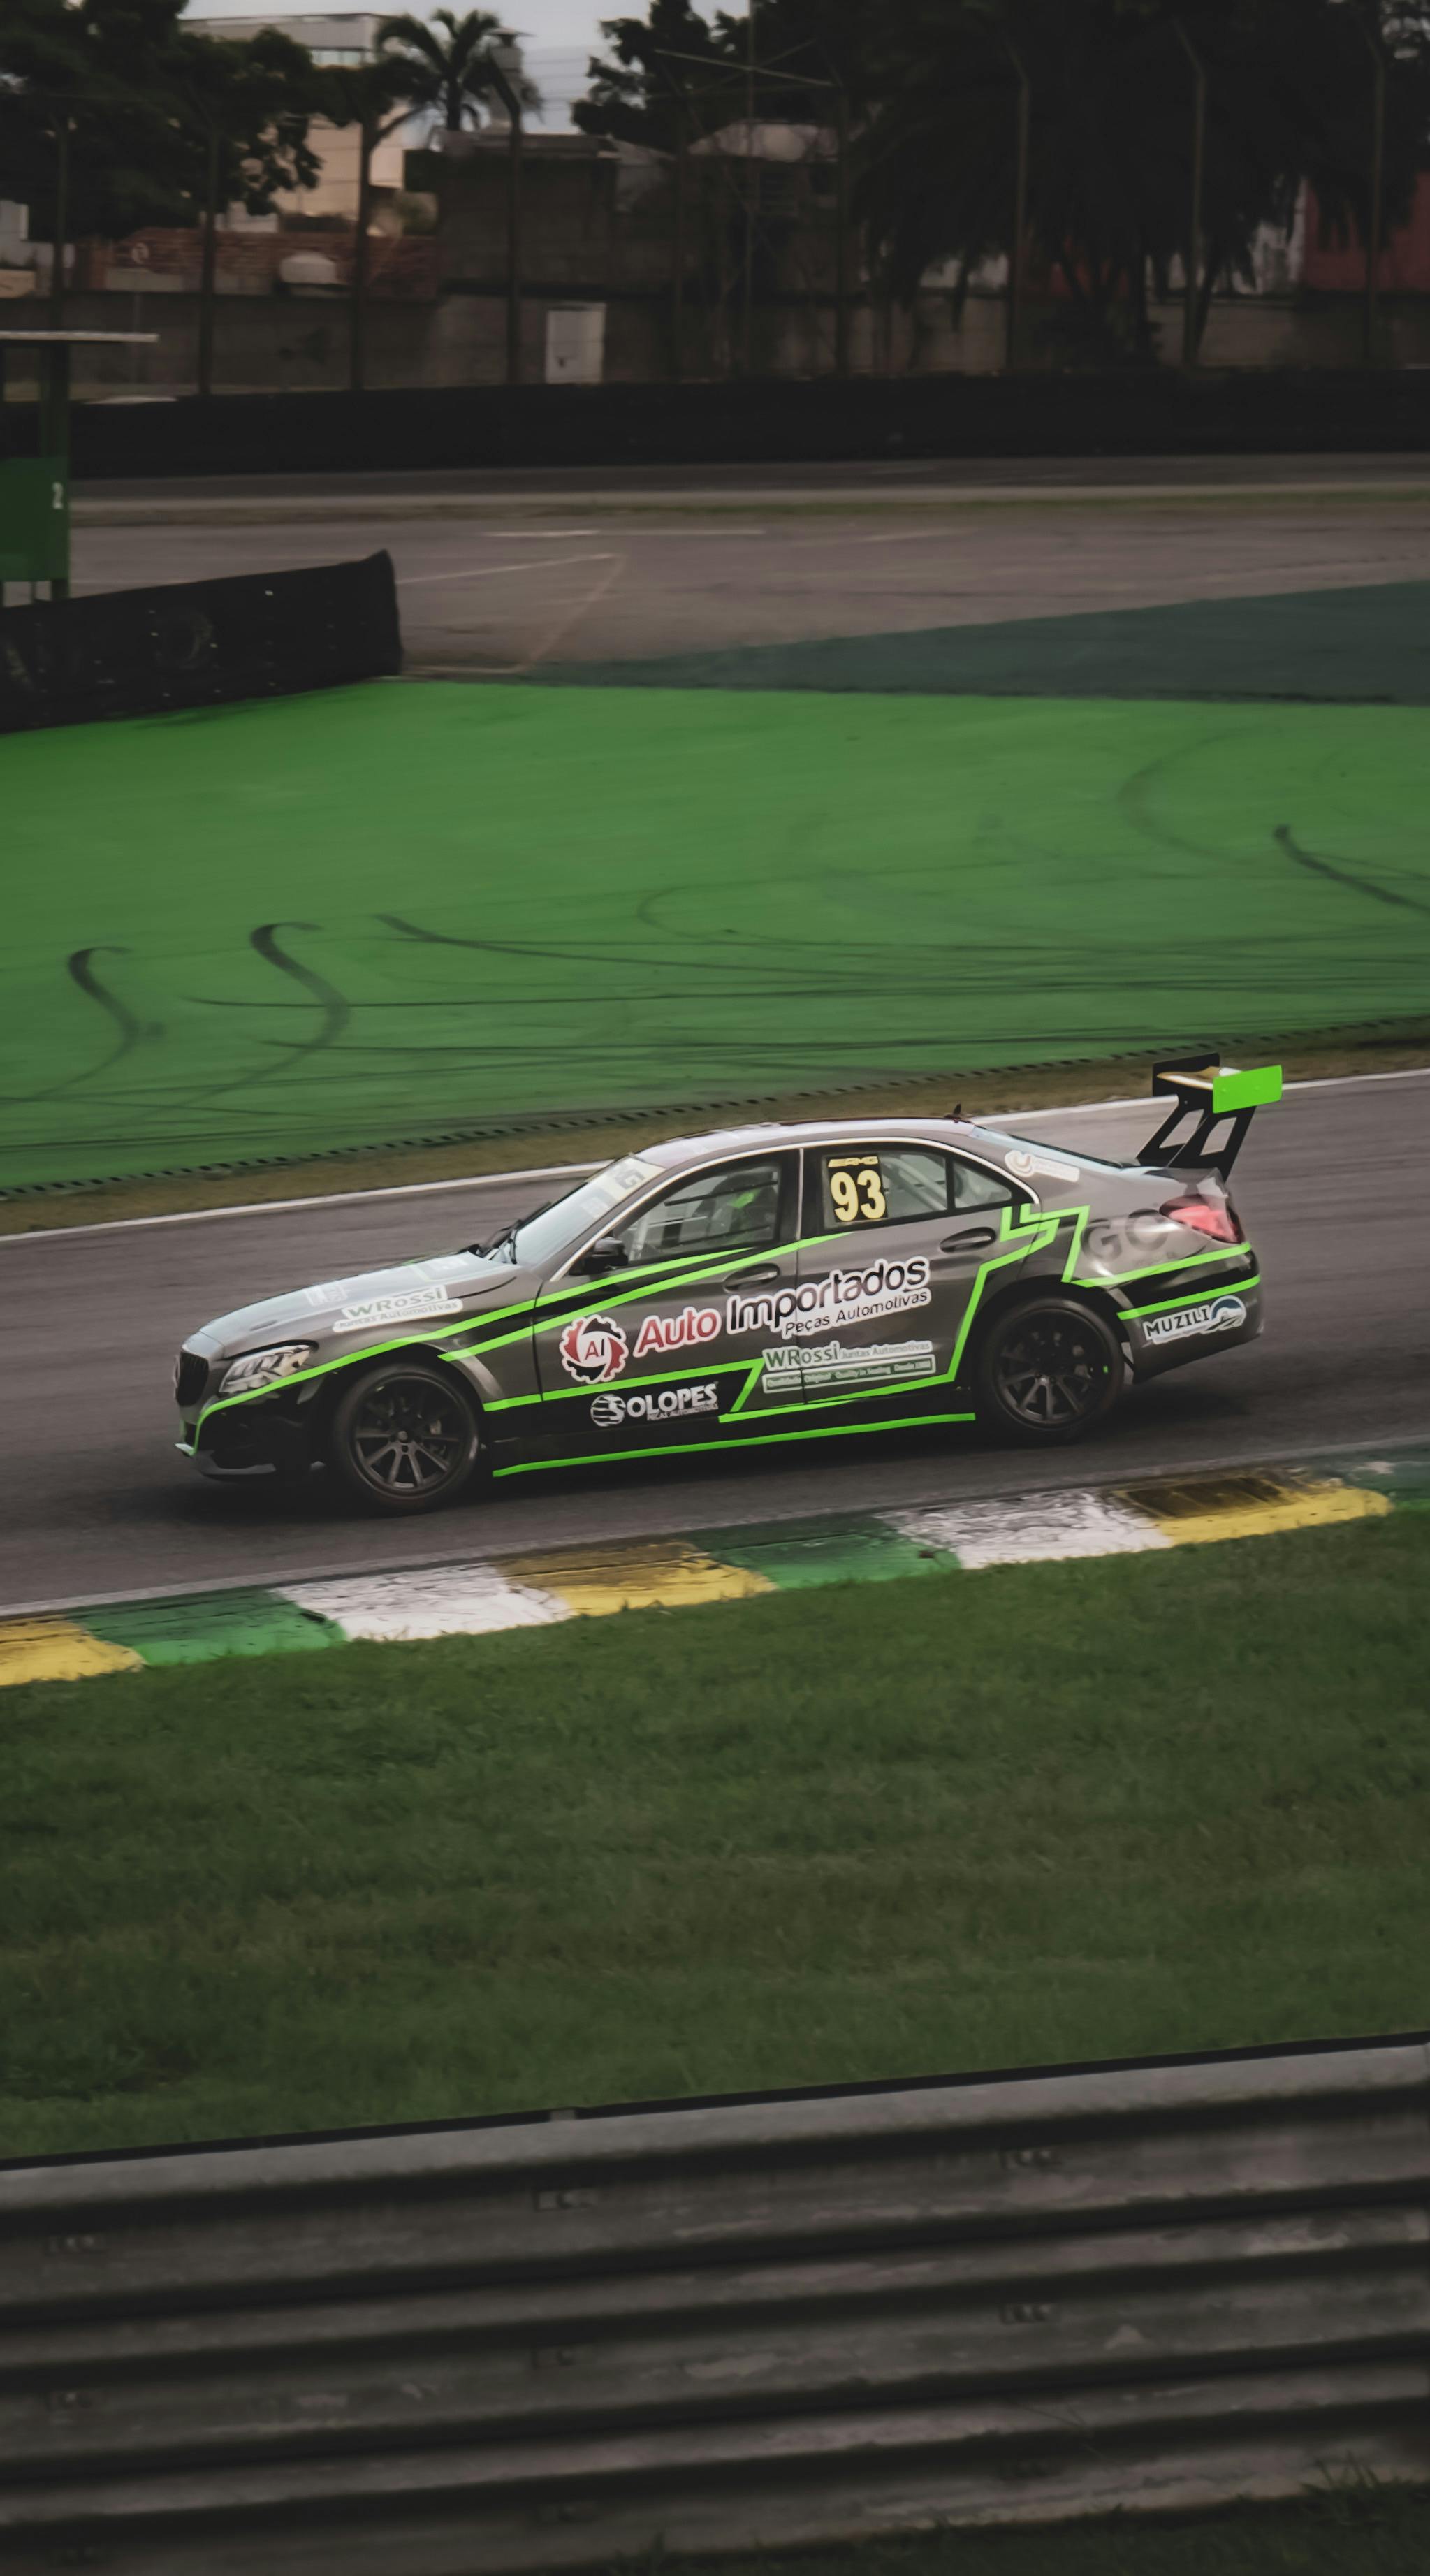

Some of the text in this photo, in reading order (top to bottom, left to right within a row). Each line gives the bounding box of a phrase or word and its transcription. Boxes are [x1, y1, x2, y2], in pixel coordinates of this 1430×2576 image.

[831, 1170, 886, 1221] 93
[348, 1287, 442, 1317] WRossi
[380, 1302, 458, 1320] Automotivas
[638, 1260, 926, 1353] Auto Importados
[785, 1290, 928, 1335] Peças Automotivas
[1146, 1308, 1209, 1337] MUZILI
[768, 1342, 930, 1367] WRossi Juntas Automotivas
